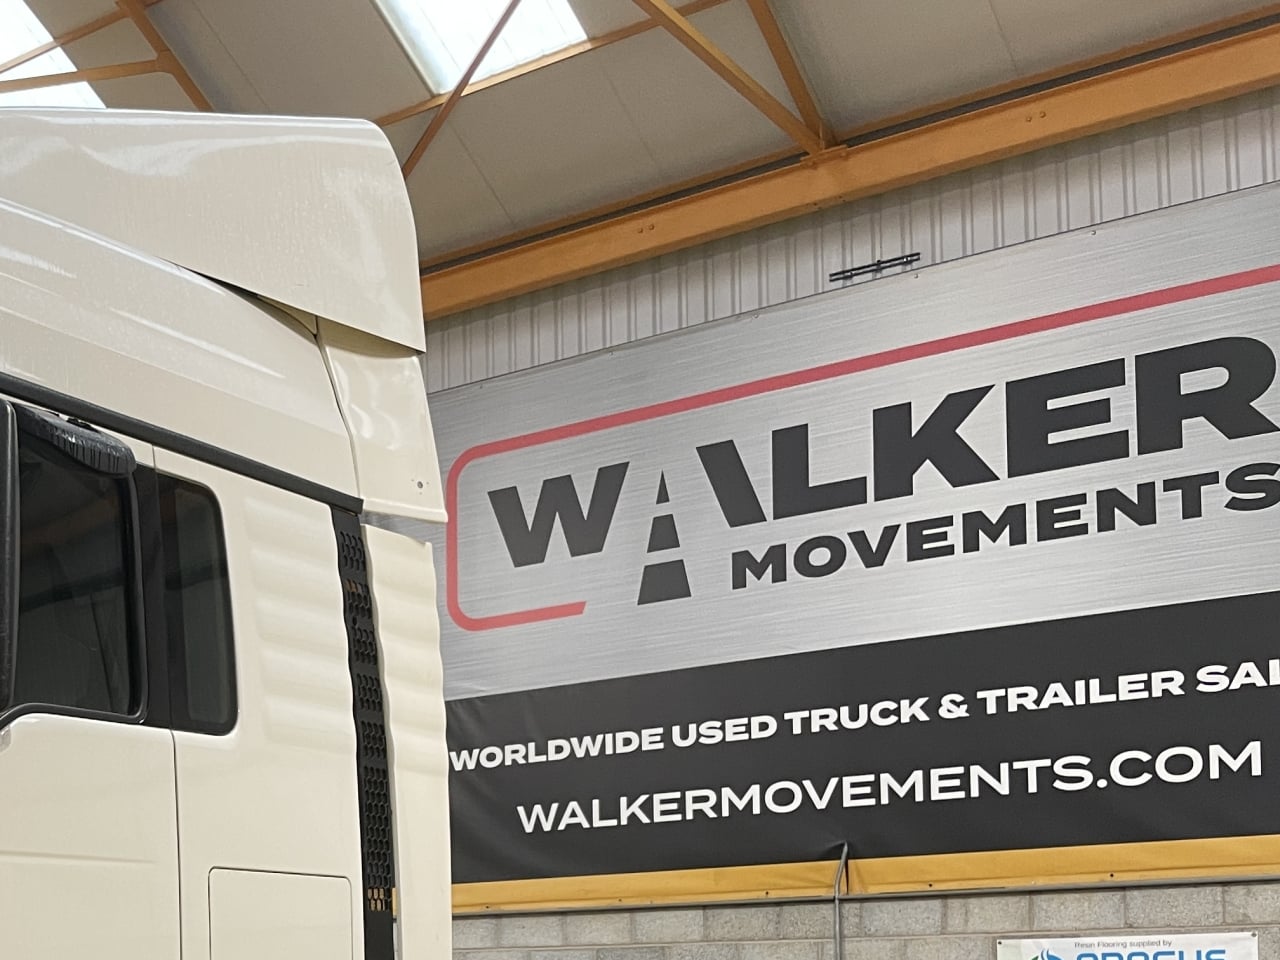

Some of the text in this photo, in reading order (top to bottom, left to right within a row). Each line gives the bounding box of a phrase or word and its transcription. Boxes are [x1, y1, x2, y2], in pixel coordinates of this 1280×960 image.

[488, 337, 1280, 605] WALKER
[732, 463, 1280, 590] MOVEMENTS
[450, 727, 664, 771] WORLDWIDE
[672, 715, 777, 748] USED
[784, 697, 930, 735] TRUCK
[938, 694, 970, 719] &
[976, 670, 1185, 714] TRAILER
[517, 740, 1262, 833] WALKERMOVEMENTS.COM
[1097, 940, 1128, 949] Flooring
[1129, 939, 1161, 948] supplied
[1162, 939, 1173, 947] by
